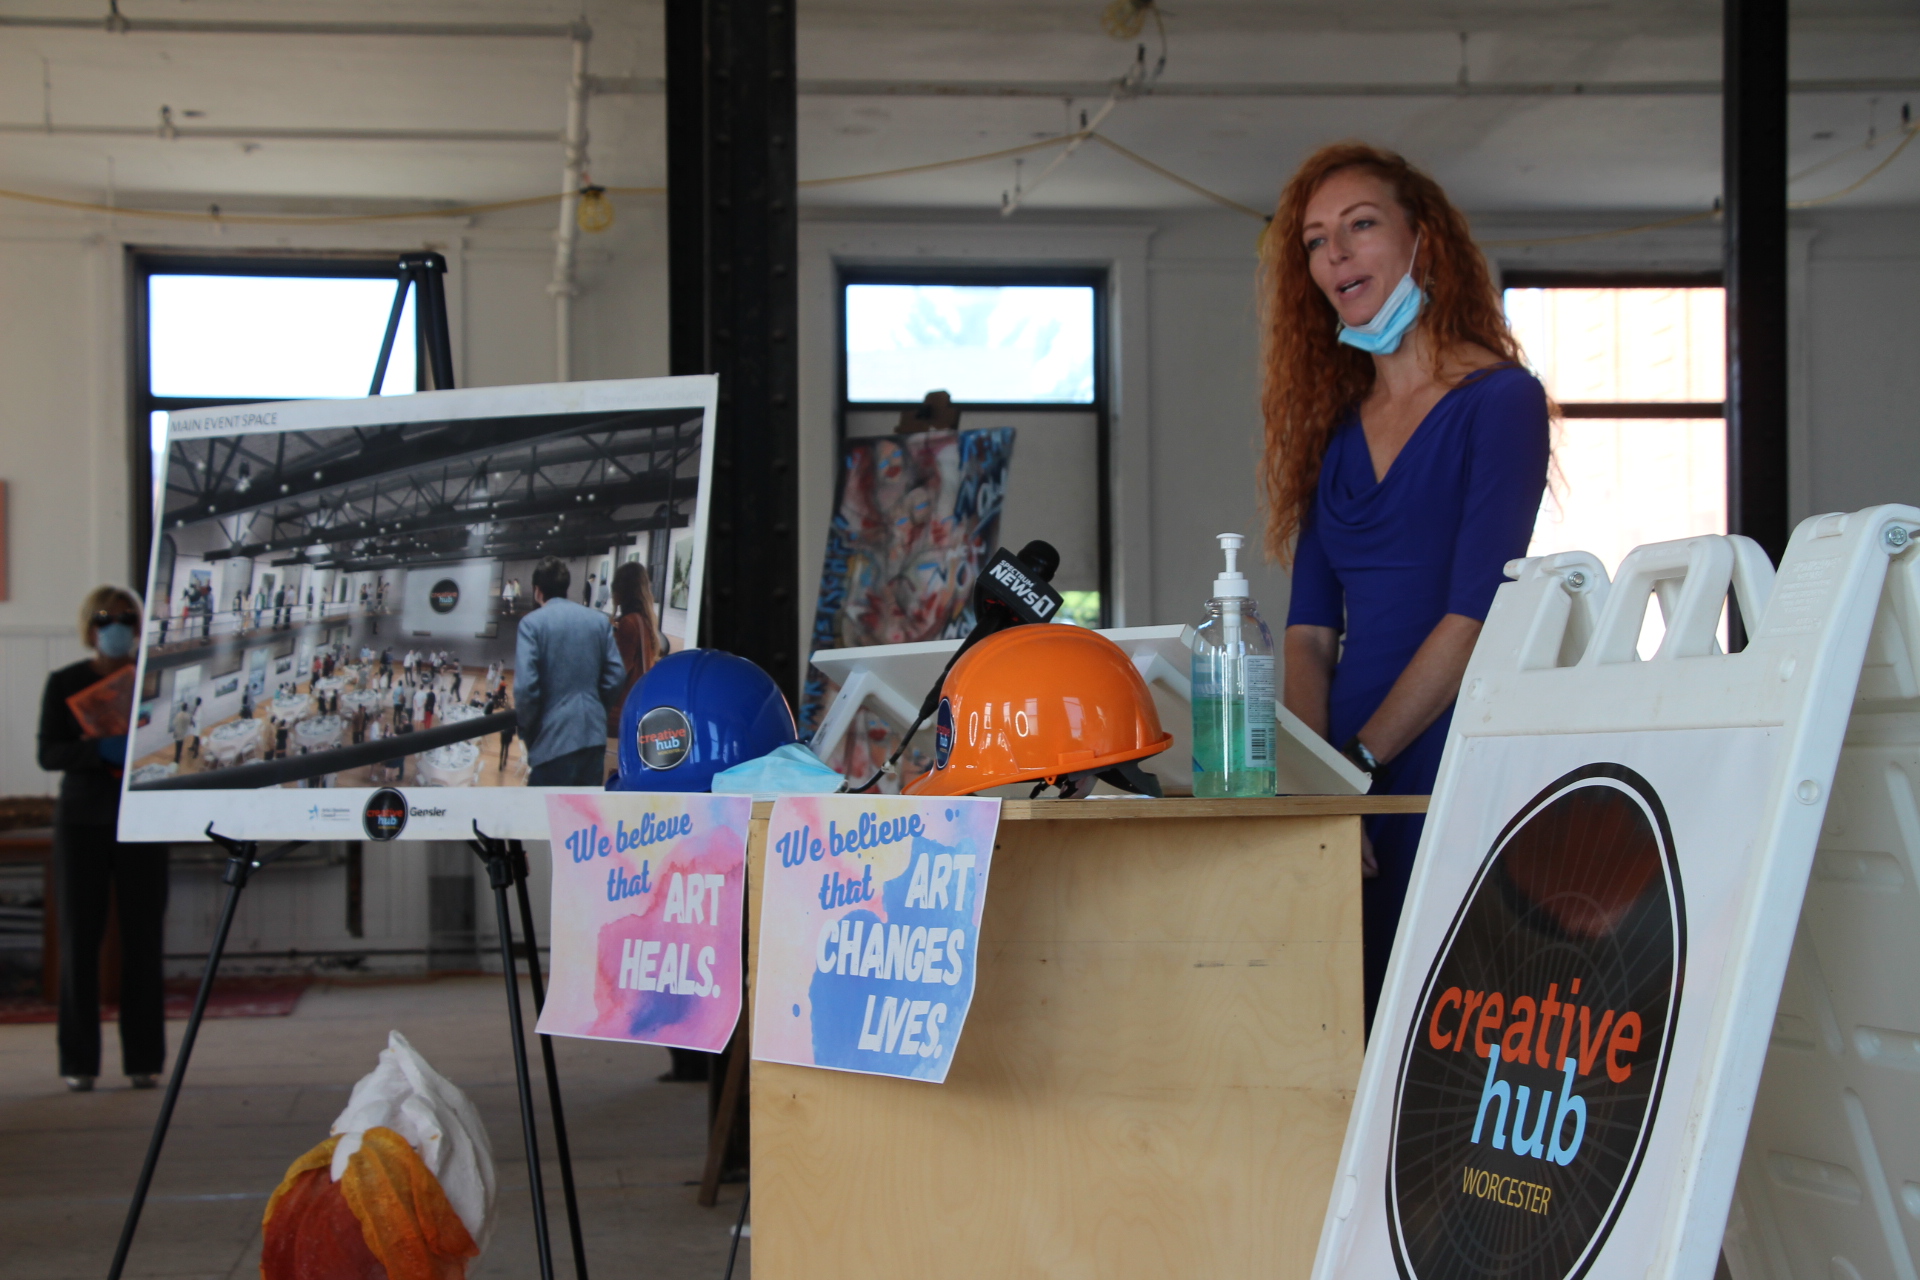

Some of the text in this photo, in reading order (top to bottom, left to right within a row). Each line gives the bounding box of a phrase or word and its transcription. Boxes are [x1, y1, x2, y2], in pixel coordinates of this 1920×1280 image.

[170, 412, 278, 432] MAIN EVENT SPACE
[988, 564, 1040, 606] NEWS
[999, 559, 1034, 588] SPECTRUM
[639, 728, 686, 744] creative
[655, 736, 680, 750] hub
[366, 808, 404, 818] creative
[377, 815, 397, 826] hub
[409, 807, 447, 817] Gensler
[565, 813, 692, 864] We believe
[775, 812, 925, 868] We believe
[606, 860, 652, 902] that
[662, 872, 725, 926] ART
[818, 864, 875, 910] that
[904, 852, 976, 912] ART
[618, 938, 720, 998] HEALS.
[816, 919, 965, 986] CHANGES
[857, 994, 947, 1059] LIVES.
[1428, 978, 1642, 1083] creative
[1470, 1043, 1587, 1167] hub
[1462, 1166, 1552, 1216] WORCESTER
